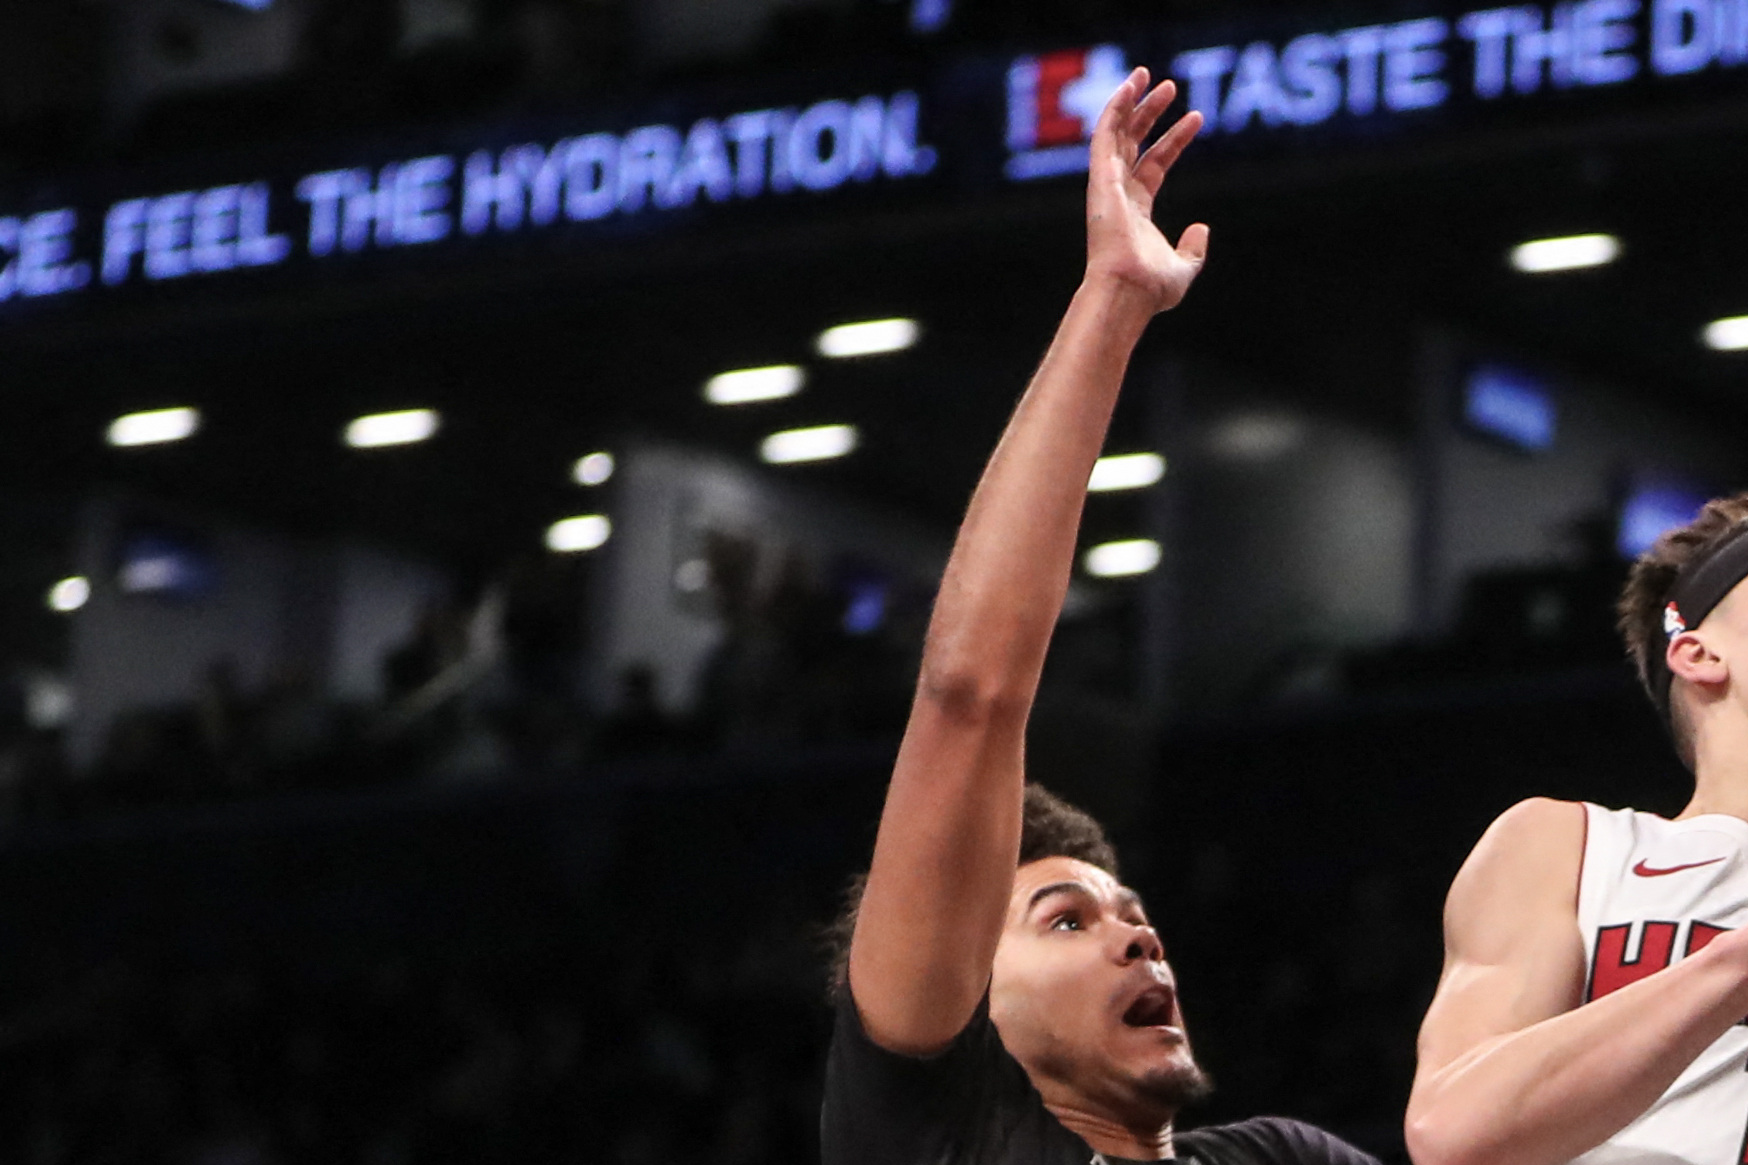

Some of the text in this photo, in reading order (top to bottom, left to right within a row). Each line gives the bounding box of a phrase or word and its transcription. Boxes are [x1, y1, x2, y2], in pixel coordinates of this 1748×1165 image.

[1170, 16, 1450, 136] TASTE
[1456, 0, 1642, 99] THE
[101, 182, 292, 284] FEEL
[295, 154, 455, 256] THE
[460, 90, 938, 236] HYDRATION.
